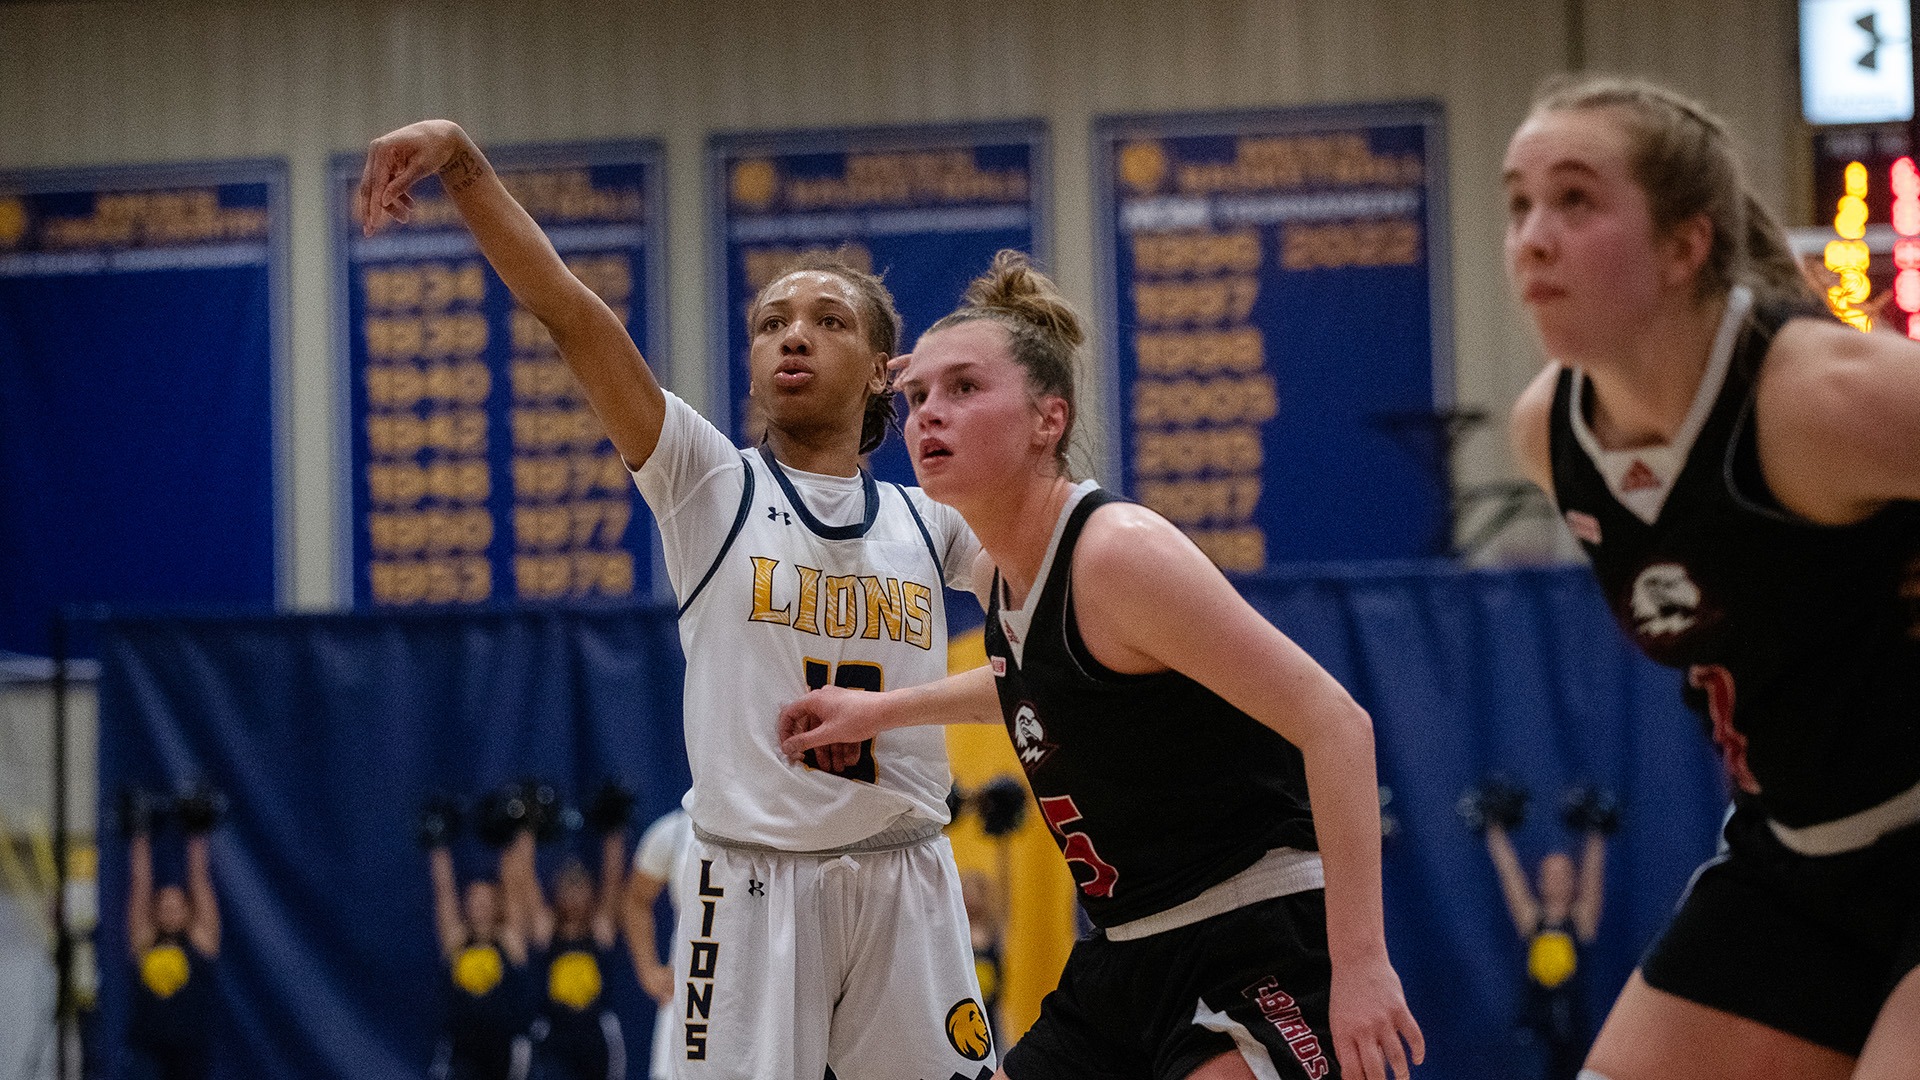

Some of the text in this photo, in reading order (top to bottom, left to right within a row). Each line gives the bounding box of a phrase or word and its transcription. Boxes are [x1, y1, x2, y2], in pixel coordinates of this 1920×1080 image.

[514, 501, 632, 549] 1977
[515, 551, 633, 600] 1978
[748, 556, 932, 651] LIONS
[685, 859, 724, 1060] LIONS
